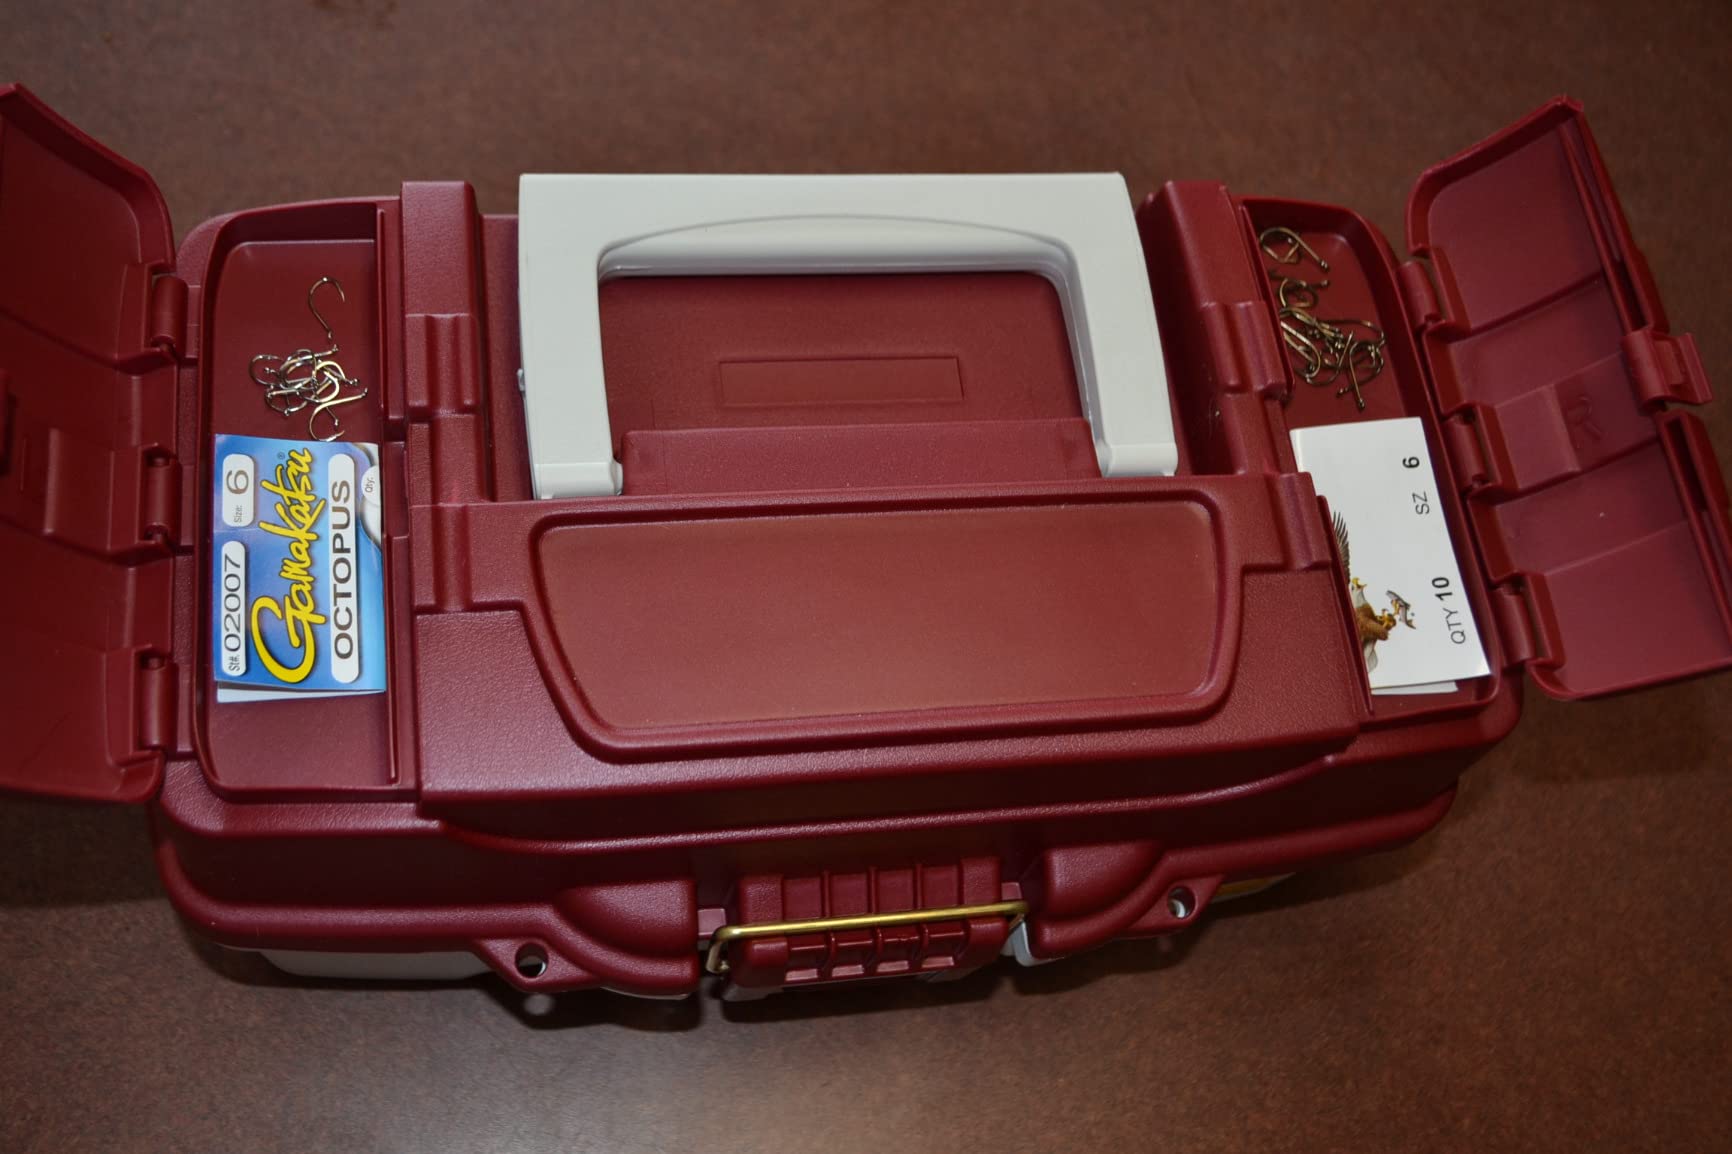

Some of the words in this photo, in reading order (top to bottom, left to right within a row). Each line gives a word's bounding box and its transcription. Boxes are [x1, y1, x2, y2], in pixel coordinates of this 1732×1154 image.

[1402, 456, 1420, 468] 6
[226, 470, 249, 495] 6
[1412, 491, 1430, 515] SZ
[331, 480, 353, 660] OCTOPUS
[1431, 577, 1453, 601] 10
[224, 554, 241, 652] 02007
[1442, 607, 1466, 644] QTY
